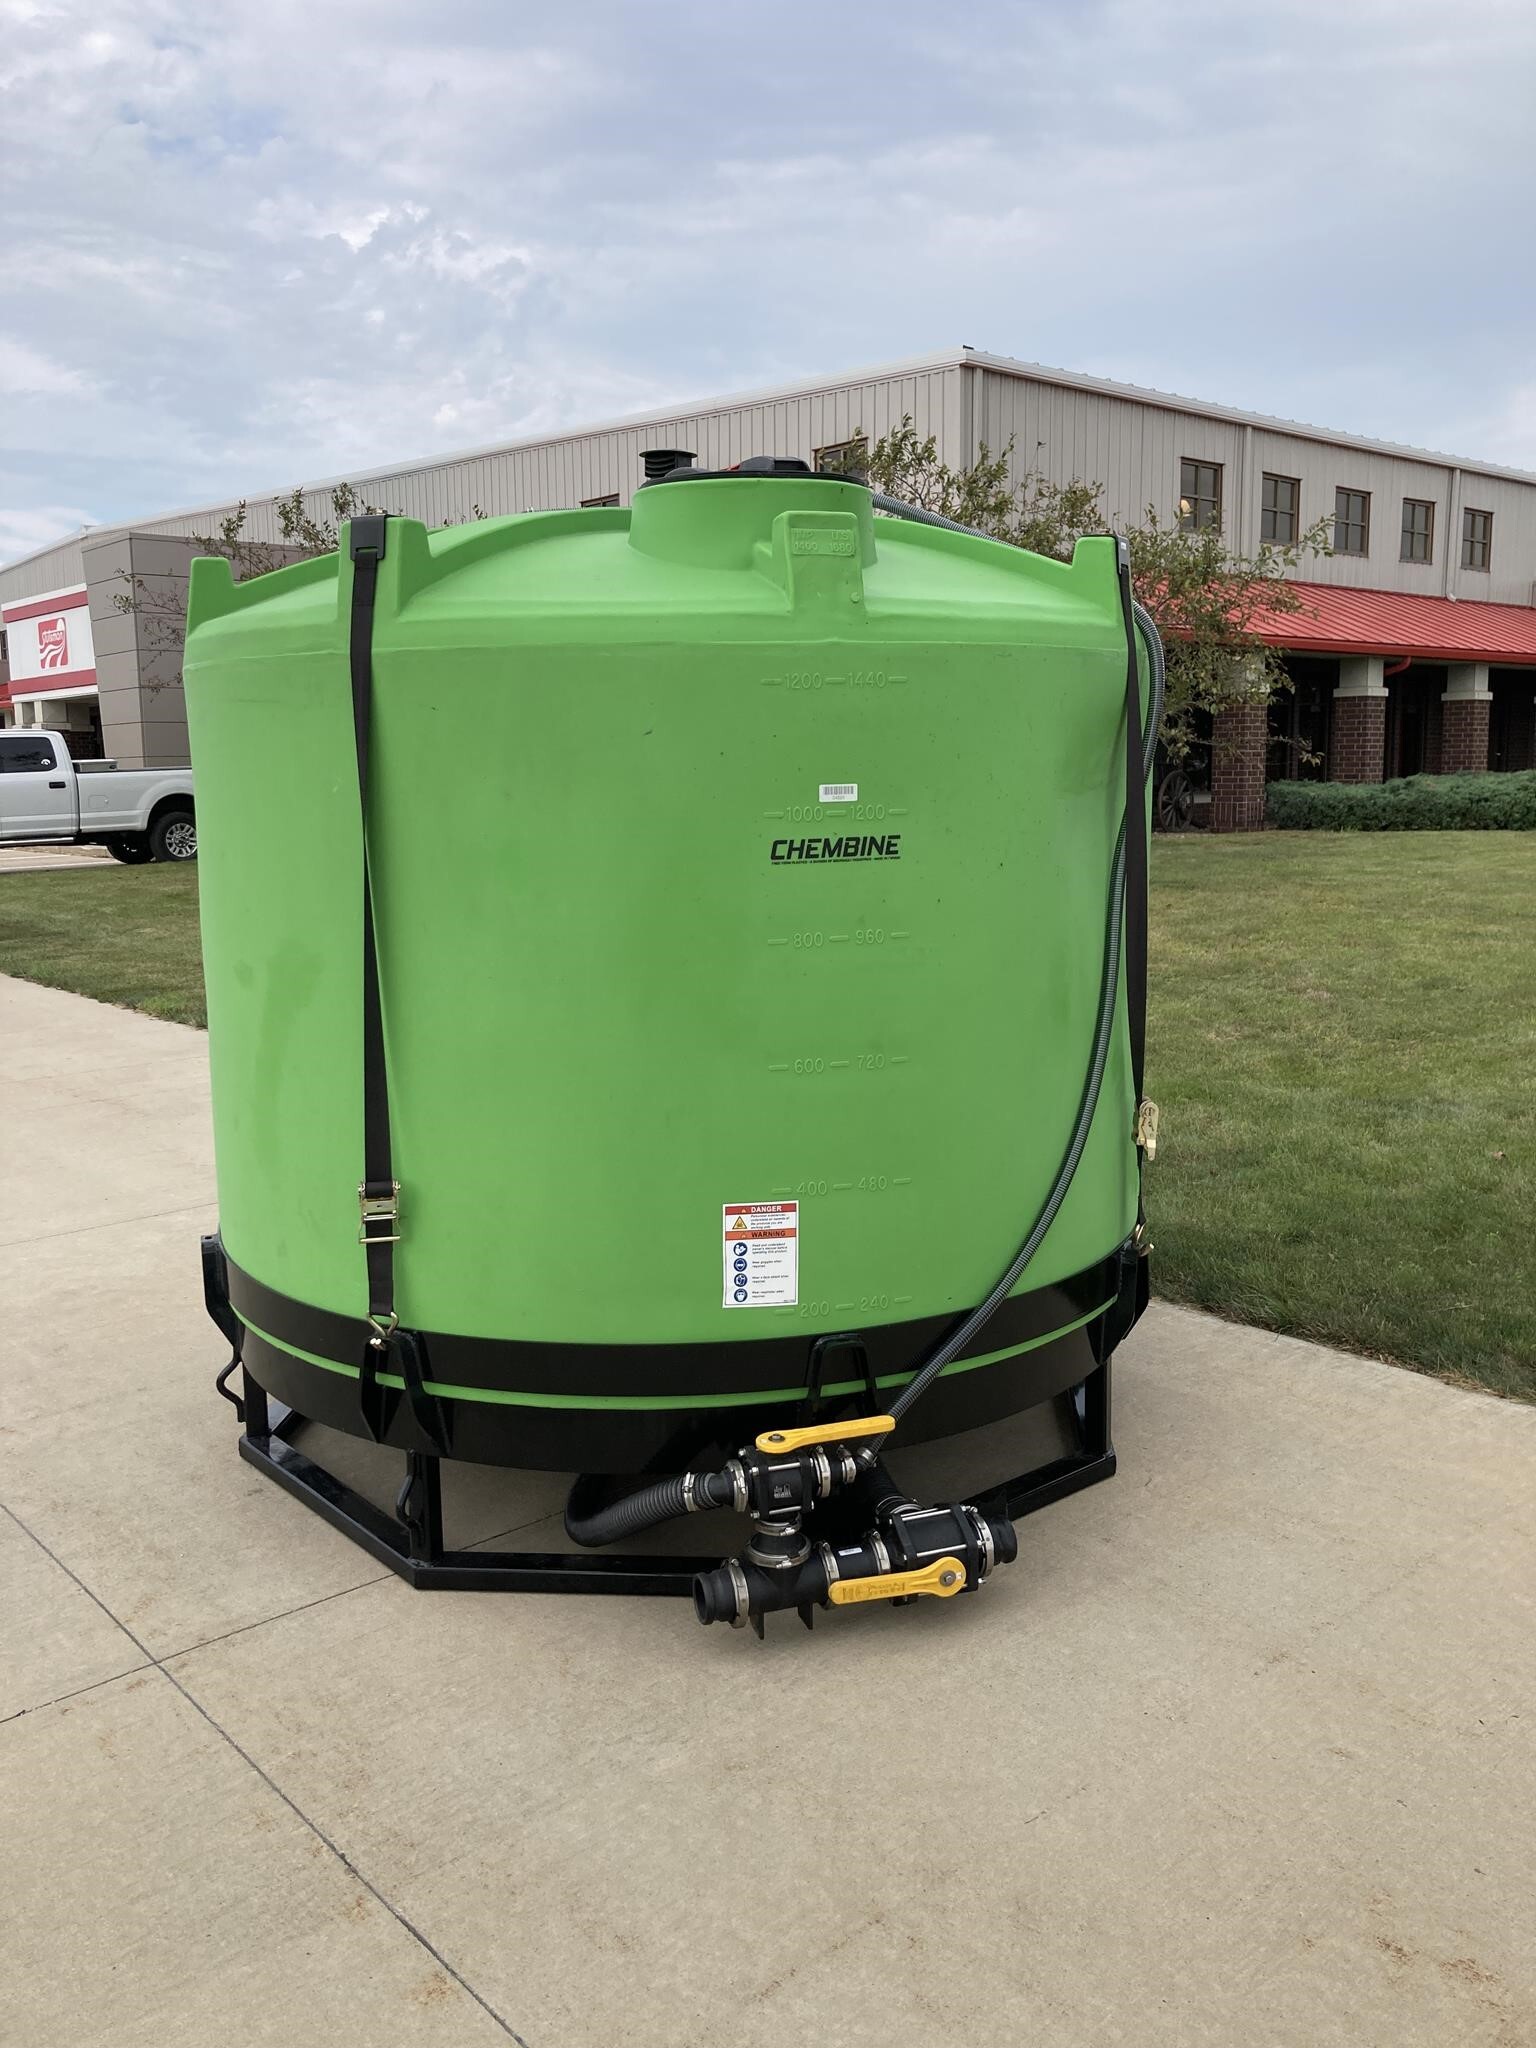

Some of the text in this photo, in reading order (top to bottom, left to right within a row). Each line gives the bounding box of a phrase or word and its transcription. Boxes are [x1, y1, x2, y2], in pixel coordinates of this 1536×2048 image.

[831, 530, 850, 541] US
[784, 671, 887, 689] 1200 1440
[787, 804, 886, 822] 1000 1200
[770, 835, 901, 861] CHEMBINE
[793, 928, 885, 948] 800 960
[793, 1053, 886, 1074] 600 720
[796, 1175, 888, 1196] 400 480
[750, 1205, 782, 1213] DANGER
[751, 1230, 786, 1238] WARNING
[800, 1294, 889, 1318] 200 240
